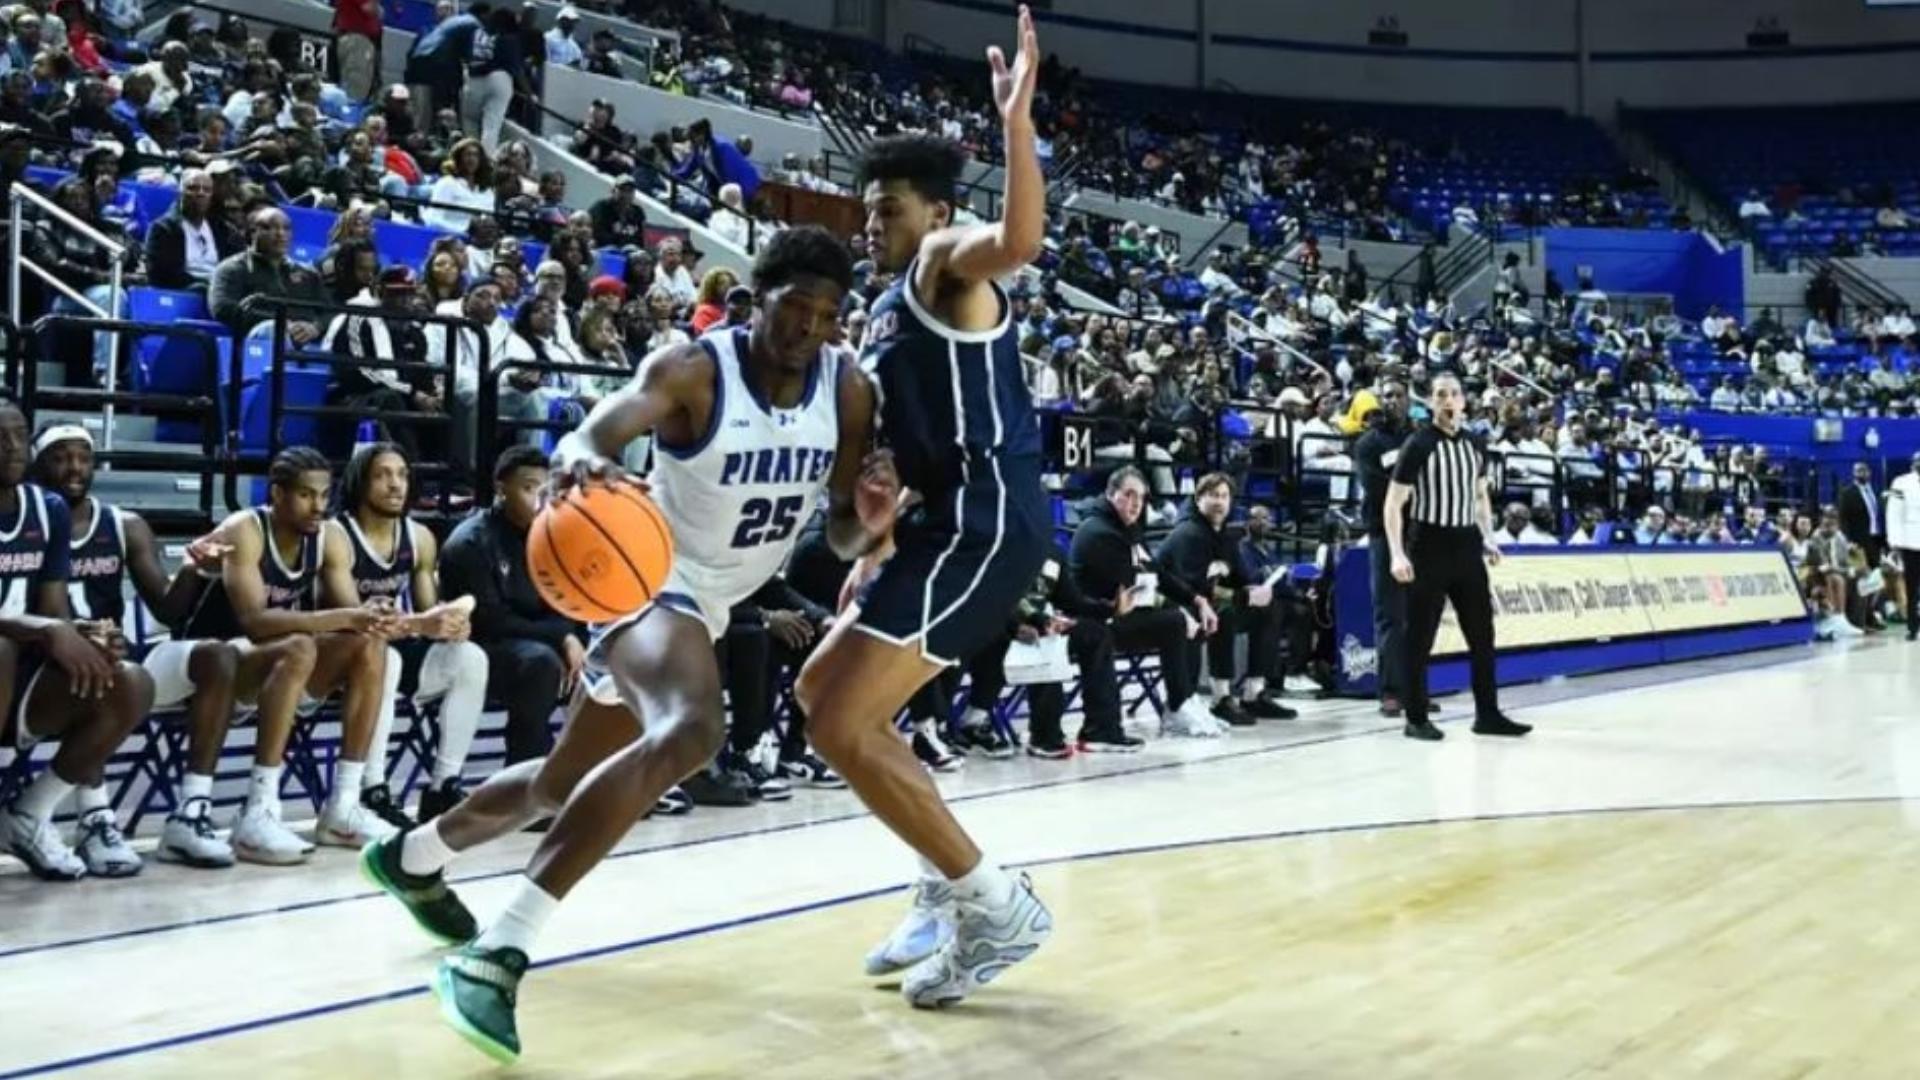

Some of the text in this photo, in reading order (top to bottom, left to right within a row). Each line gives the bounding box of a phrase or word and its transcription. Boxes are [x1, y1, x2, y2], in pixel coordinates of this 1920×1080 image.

[301, 40, 328, 73] B1
[1064, 426, 1092, 468] B1
[730, 495, 804, 549] 25
